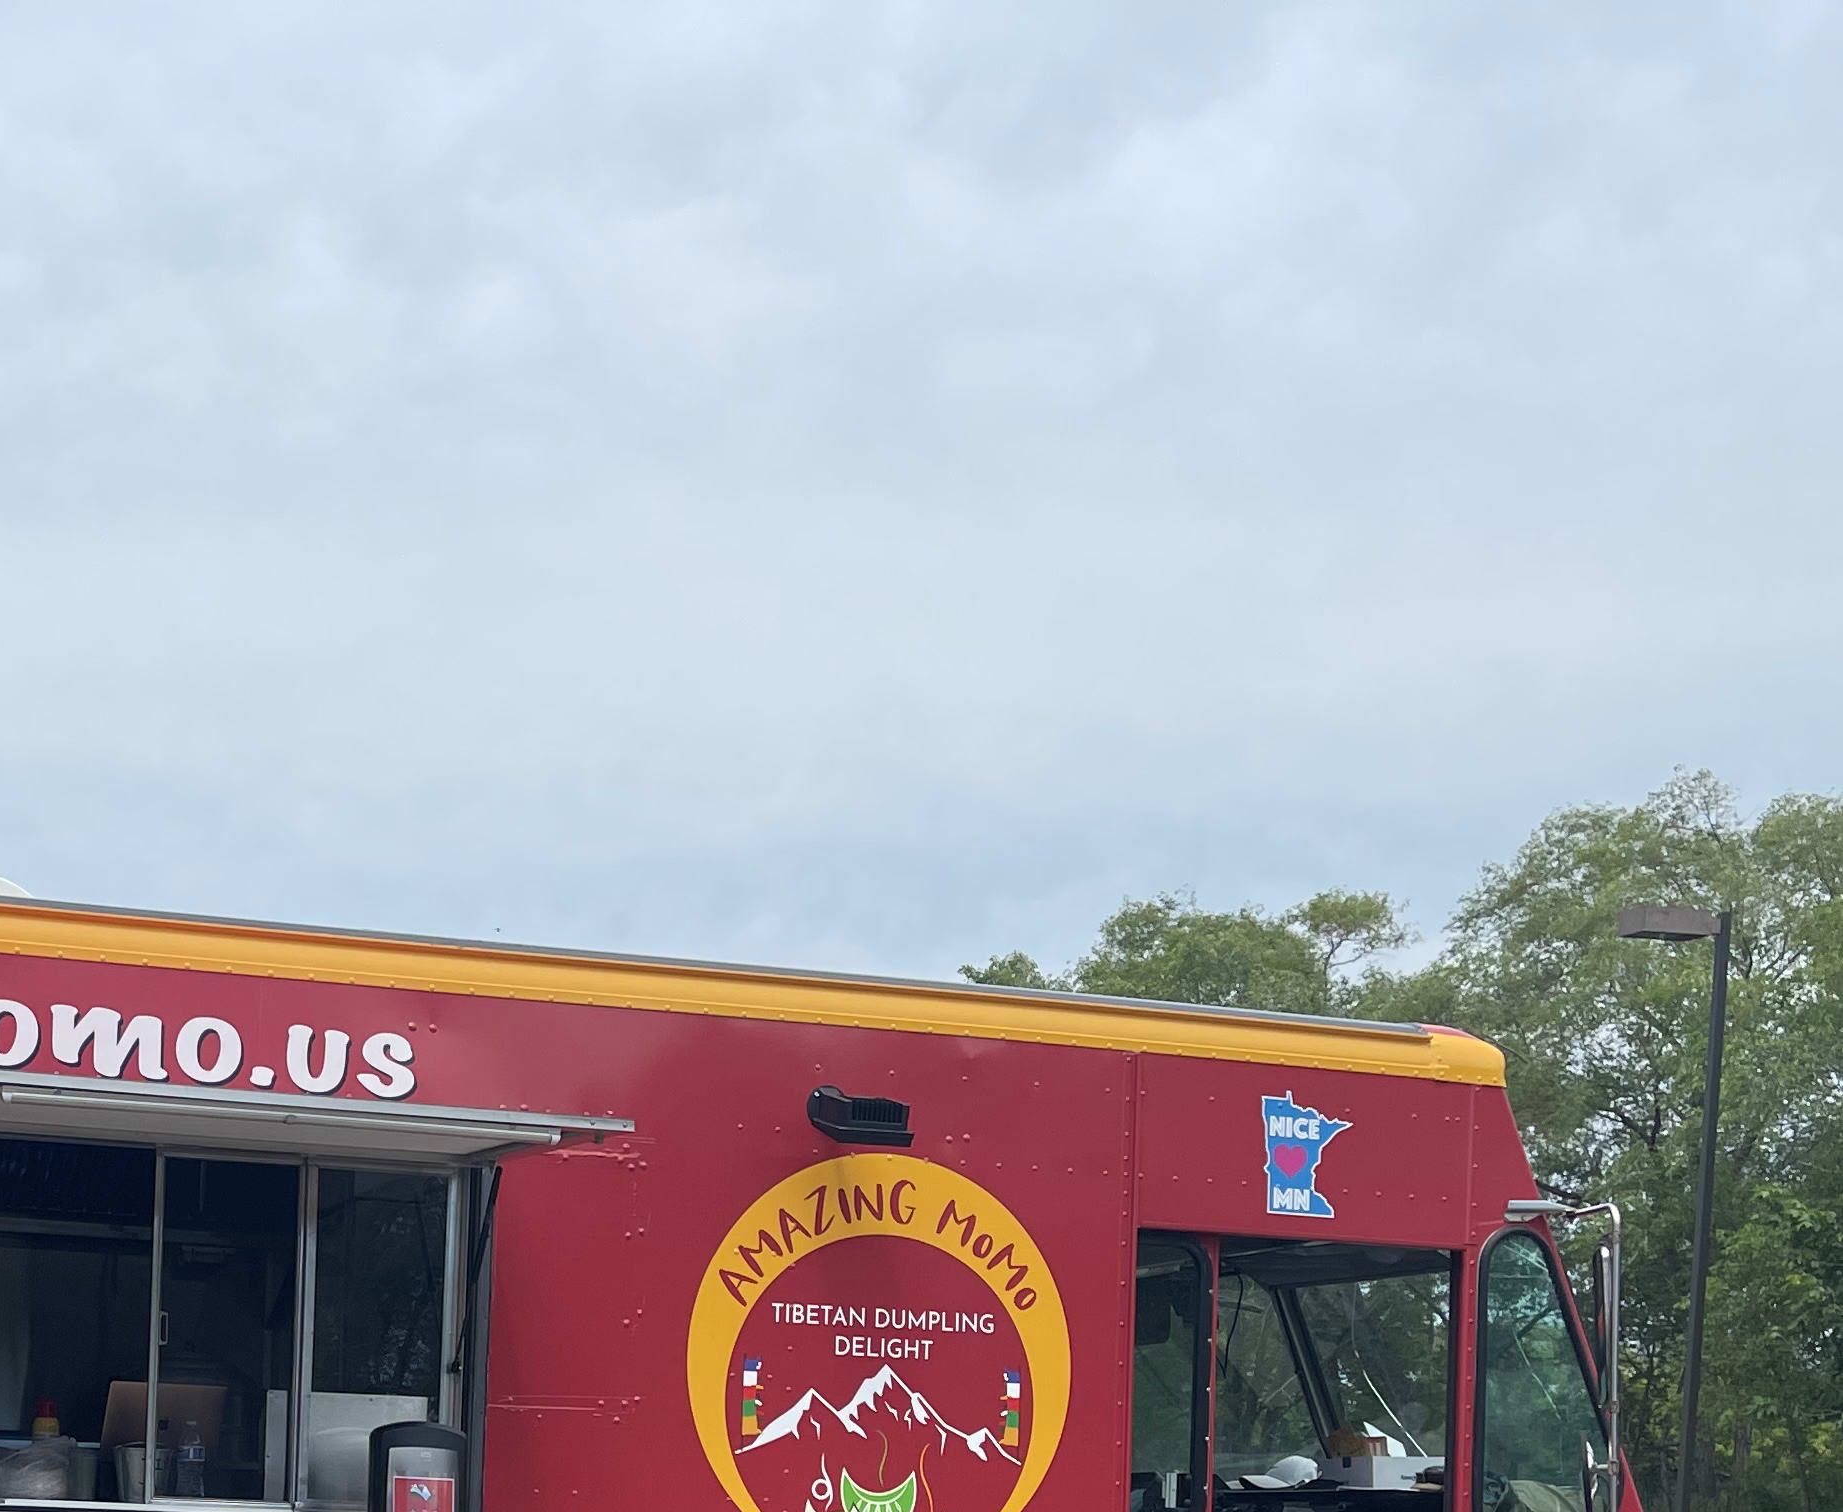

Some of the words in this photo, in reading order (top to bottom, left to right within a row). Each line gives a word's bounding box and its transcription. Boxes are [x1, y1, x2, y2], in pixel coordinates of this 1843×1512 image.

[1269, 1115, 1320, 1140] NICE
[1273, 1186, 1310, 1211] MN
[719, 1180, 916, 1306] AMAZING
[772, 1303, 865, 1327] TIBETAN
[875, 1308, 995, 1333] DUMPLING
[835, 1336, 933, 1360] DELIGHT
